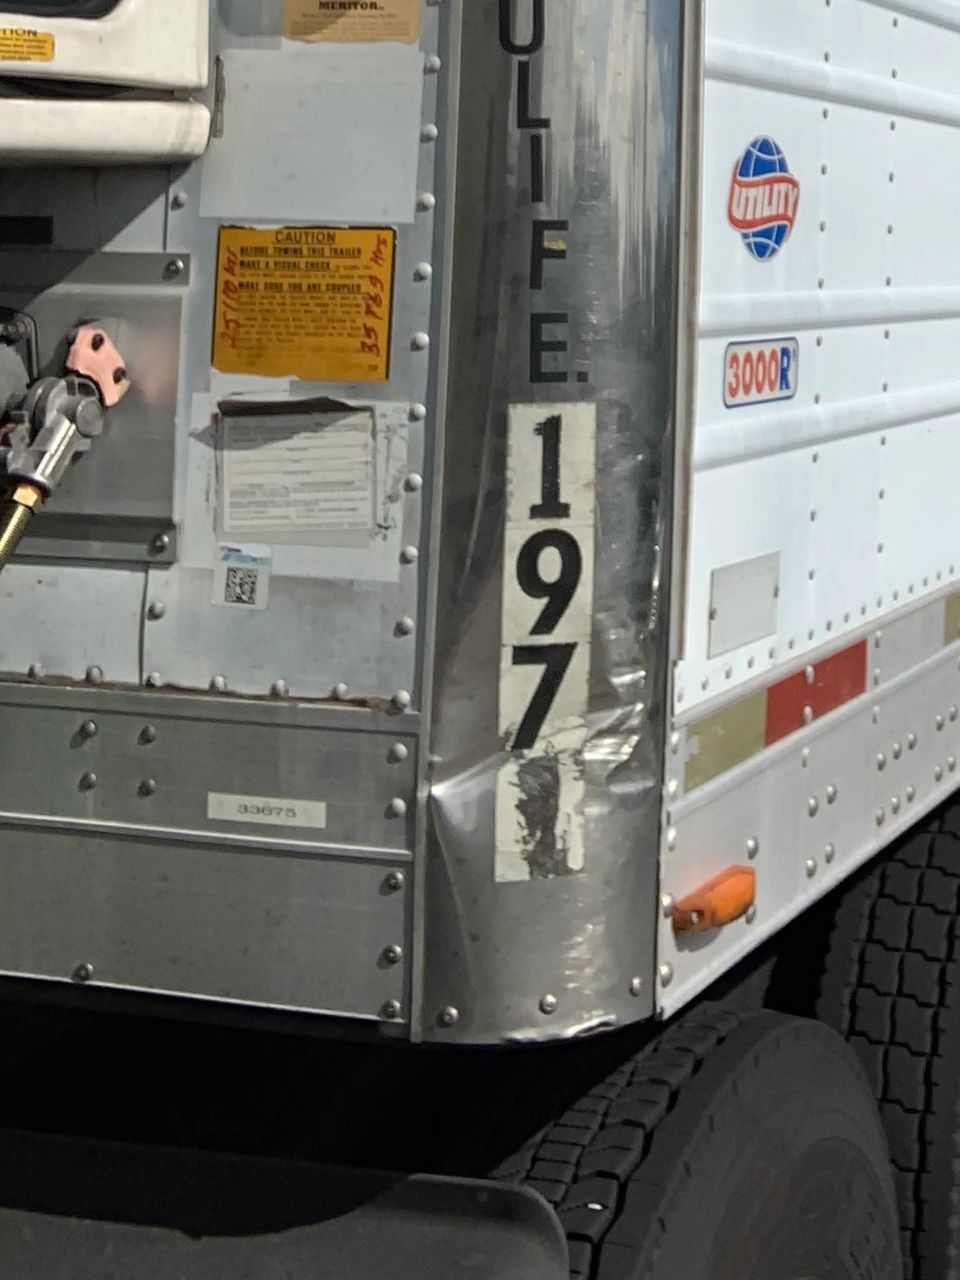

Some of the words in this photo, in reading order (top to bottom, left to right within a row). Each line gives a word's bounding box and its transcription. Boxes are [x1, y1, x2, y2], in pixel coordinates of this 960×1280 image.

[318, 0, 378, 10] MERITOR
[732, 182, 798, 219] UTILITY
[275, 231, 336, 244] CAUTION
[329, 247, 362, 257] TRAILER
[727, 346, 791, 399] 3000R
[511, 415, 583, 752] 197
